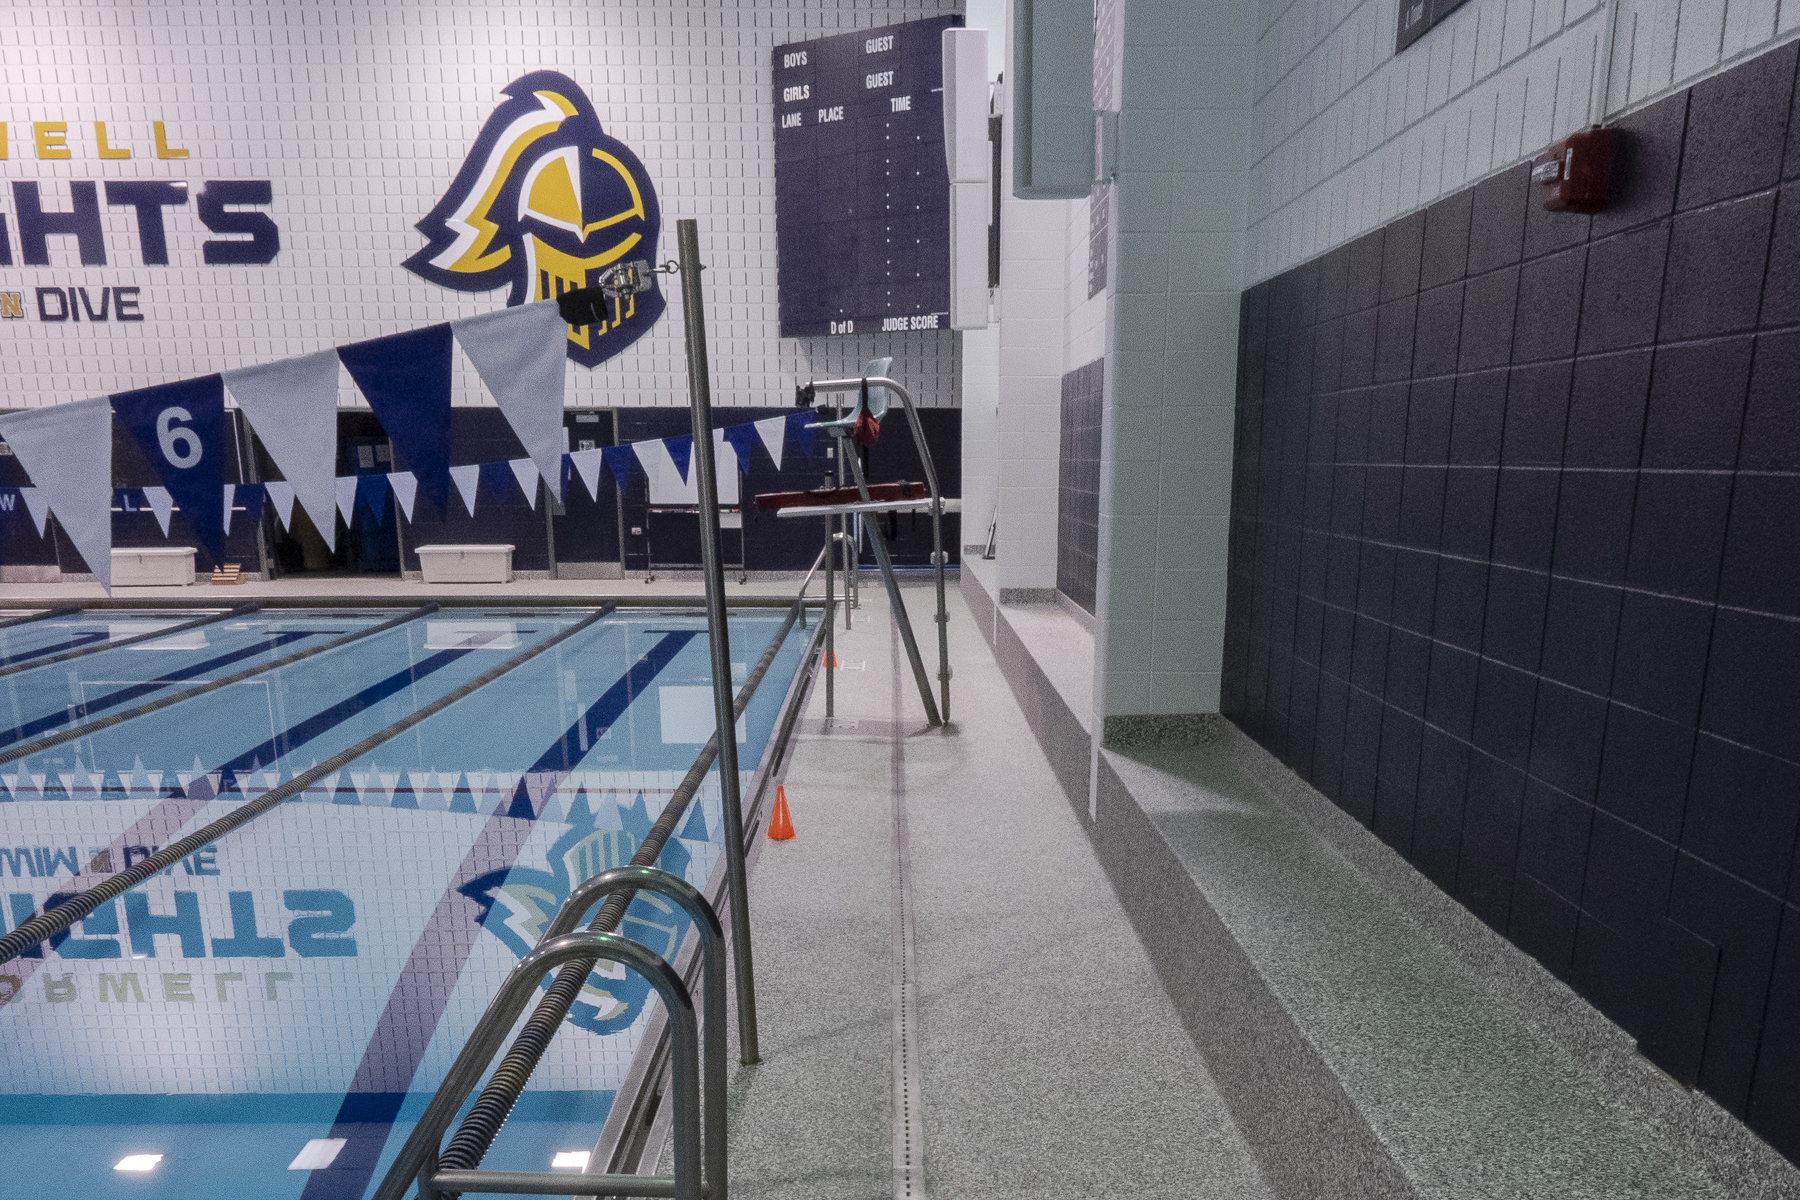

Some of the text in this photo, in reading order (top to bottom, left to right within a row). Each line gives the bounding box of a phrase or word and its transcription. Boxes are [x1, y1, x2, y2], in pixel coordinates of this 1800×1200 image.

[865, 35, 894, 54] GUEST
[783, 51, 808, 69] BOYS
[866, 71, 894, 89] GUEST
[783, 84, 810, 103] GIRLS
[781, 96, 911, 129] LANE PLACE TIME
[0, 121, 189, 160] ELL
[0, 180, 280, 265] HTS
[35, 287, 144, 321] DIVE
[830, 320, 854, 334] D of D
[881, 315, 939, 331] JUDGE SCORE
[156, 406, 203, 469] 6
